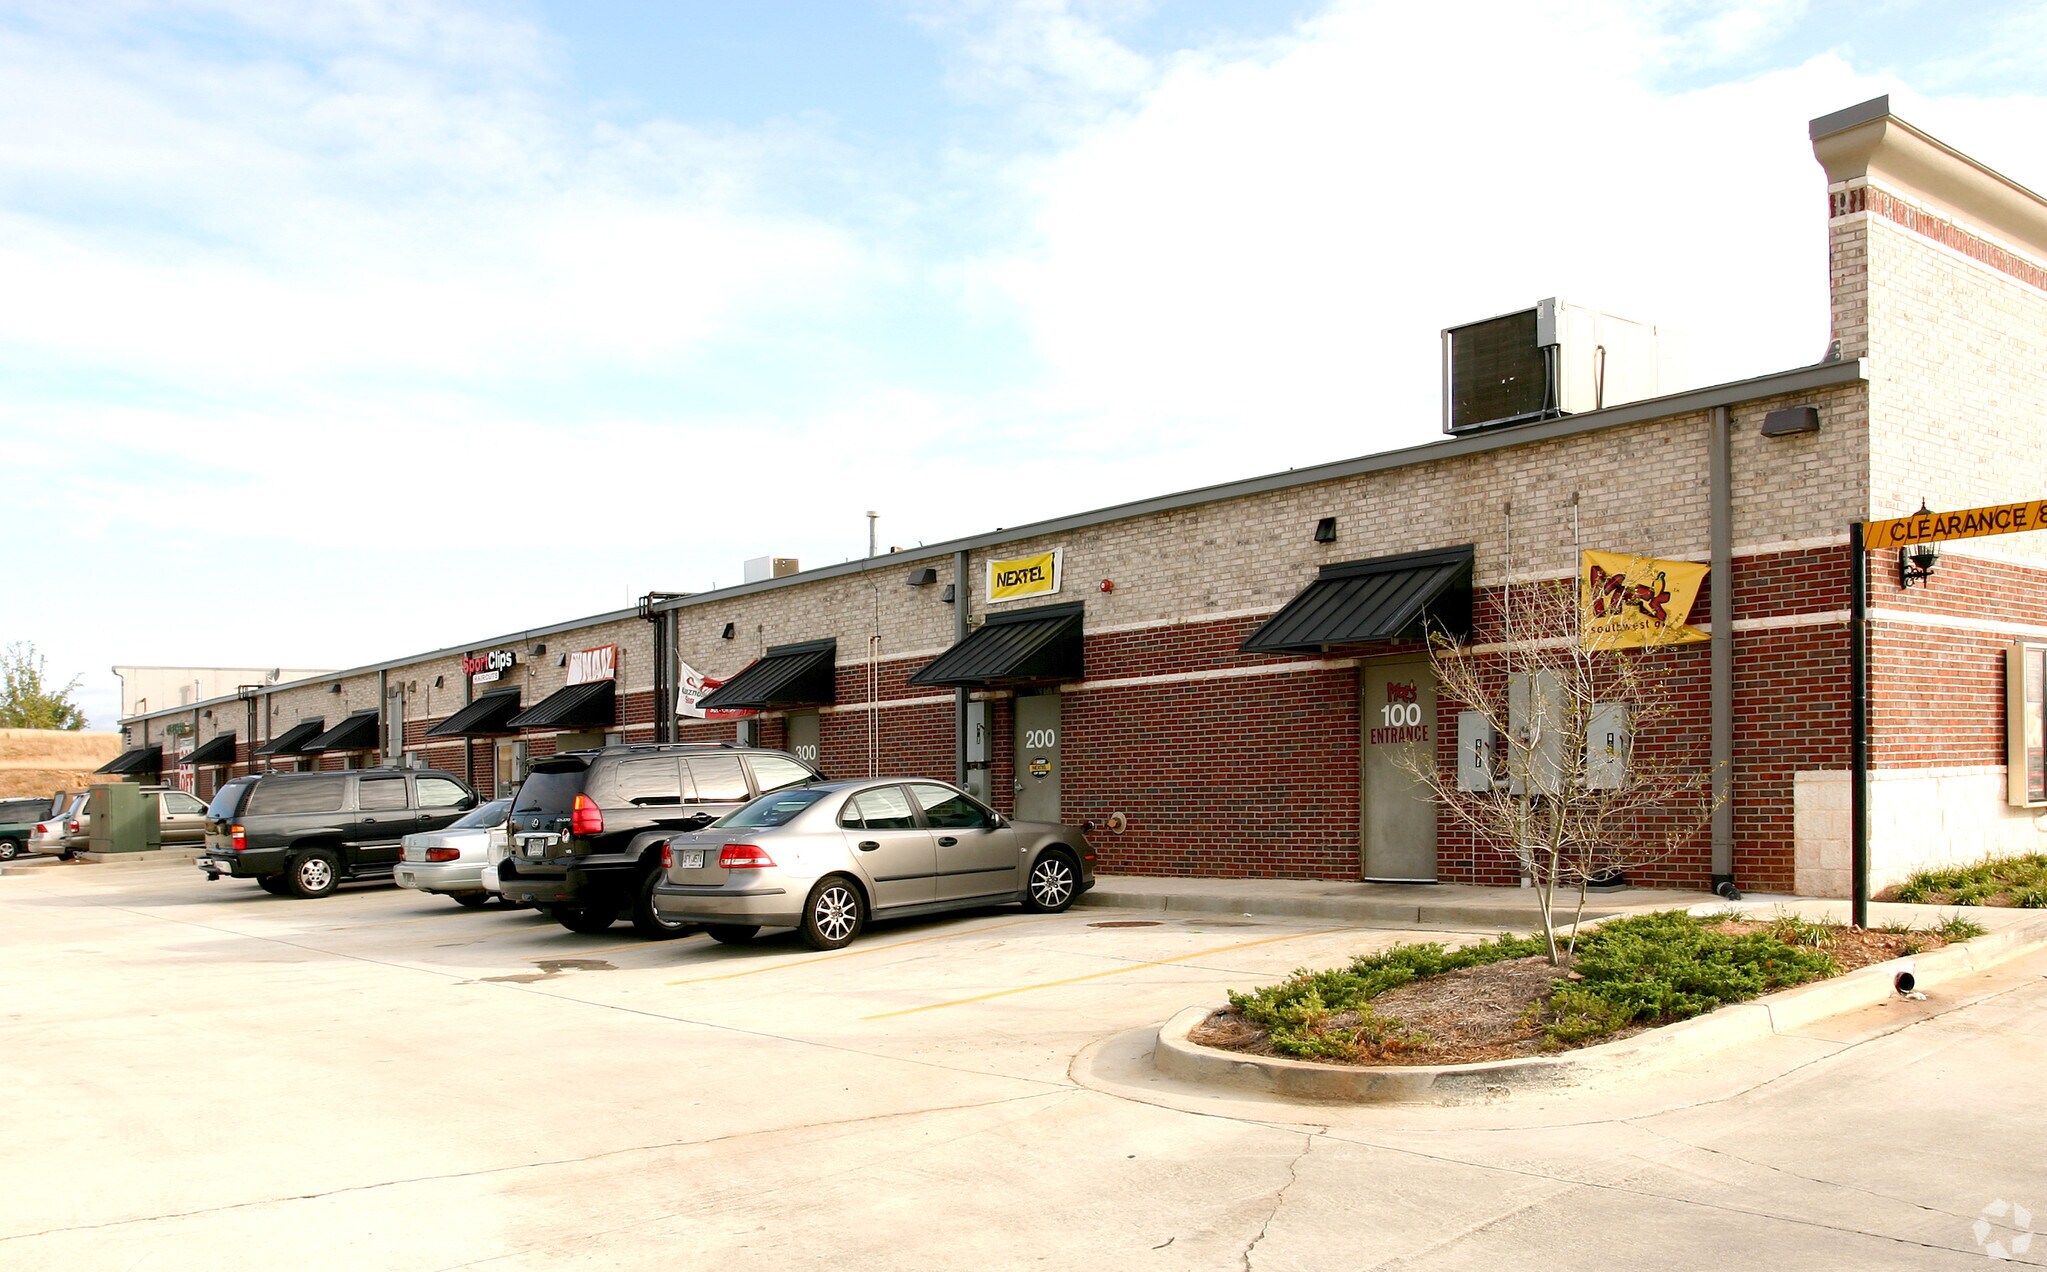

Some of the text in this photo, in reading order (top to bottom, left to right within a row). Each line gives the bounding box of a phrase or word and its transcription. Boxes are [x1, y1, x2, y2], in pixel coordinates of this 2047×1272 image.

[1890, 507, 2027, 541] CLEARANCE
[996, 566, 1045, 588] NEXTEL
[1381, 703, 1421, 727] 100
[1025, 729, 1055, 748] 200
[1371, 725, 1429, 744] ENTRANCE
[795, 745, 816, 760] 300
